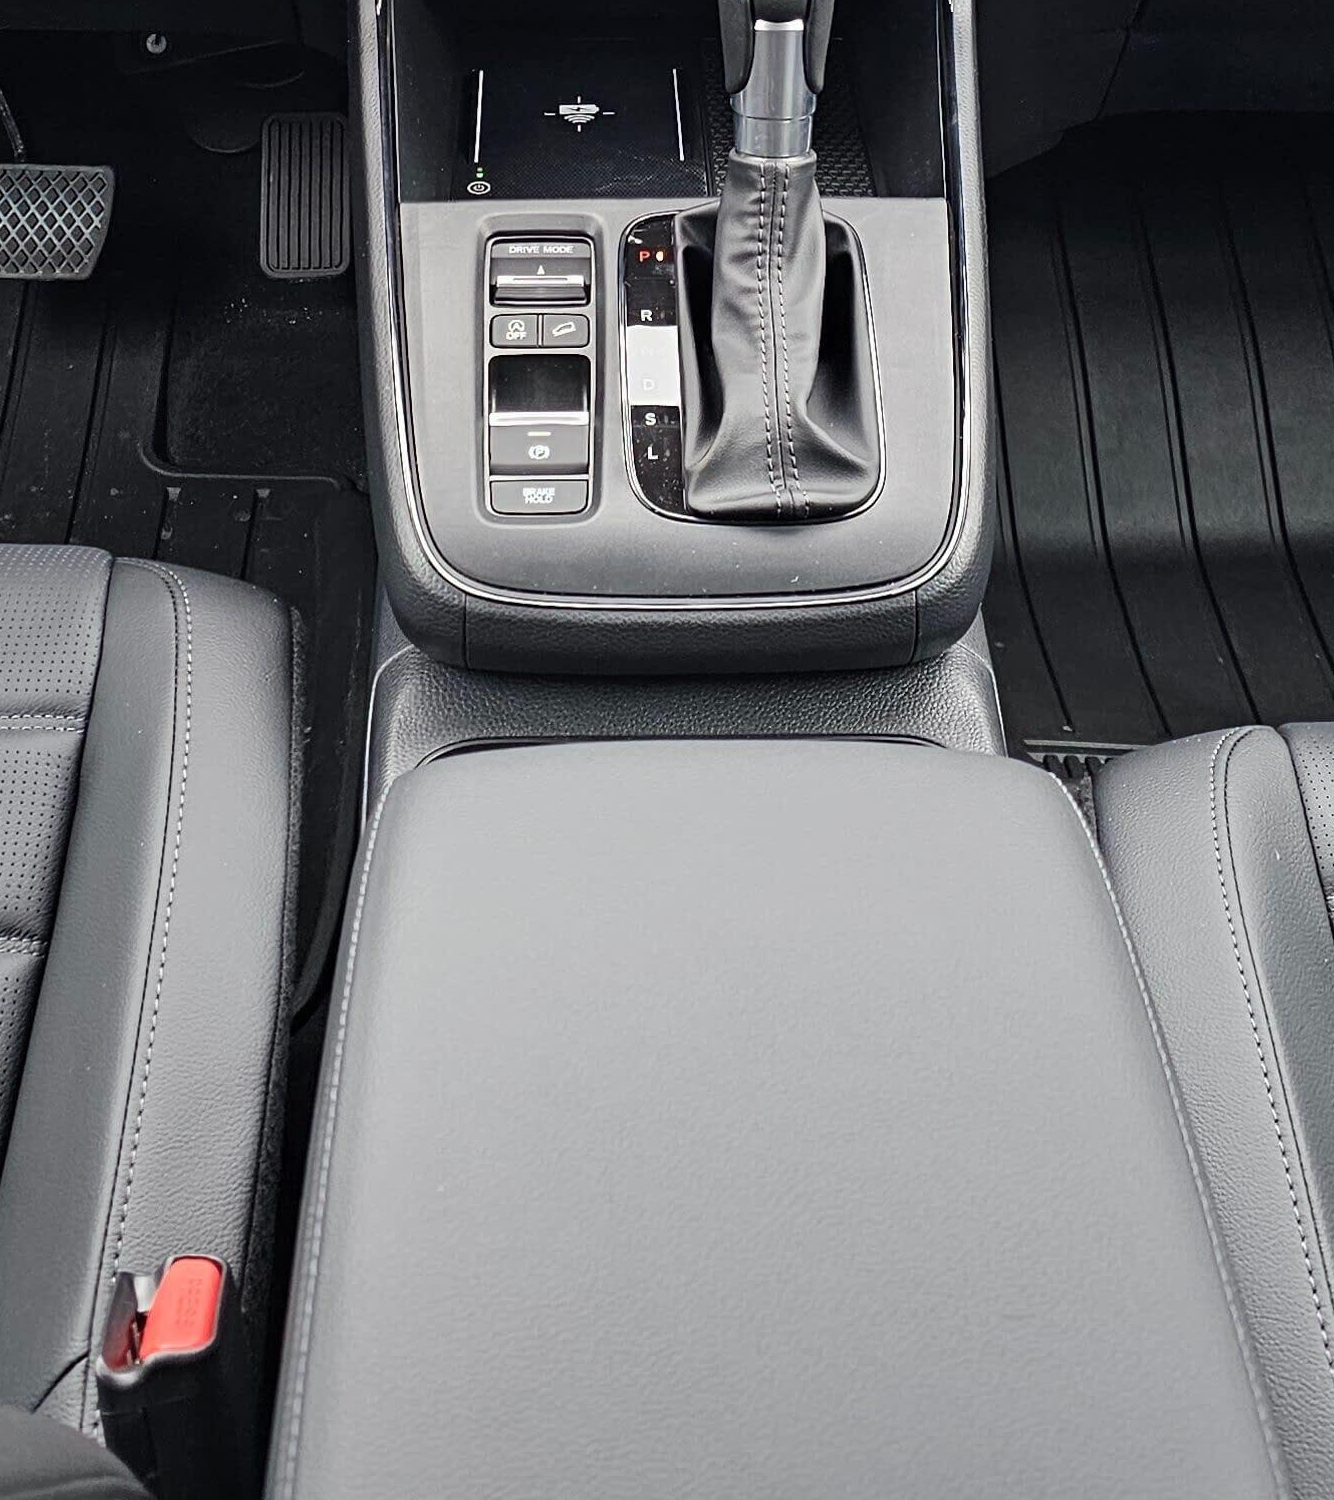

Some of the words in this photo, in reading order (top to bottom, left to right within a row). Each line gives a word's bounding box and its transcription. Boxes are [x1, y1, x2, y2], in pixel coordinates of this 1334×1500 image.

[508, 245, 540, 254] DRIVE
[543, 245, 574, 254] MODE
[639, 250, 650, 263] P
[640, 309, 653, 322] R
[506, 331, 527, 341] OFF
[645, 413, 657, 426] S
[647, 447, 659, 460] L
[522, 487, 556, 497] BRAKE
[524, 495, 554, 504] HOLD
